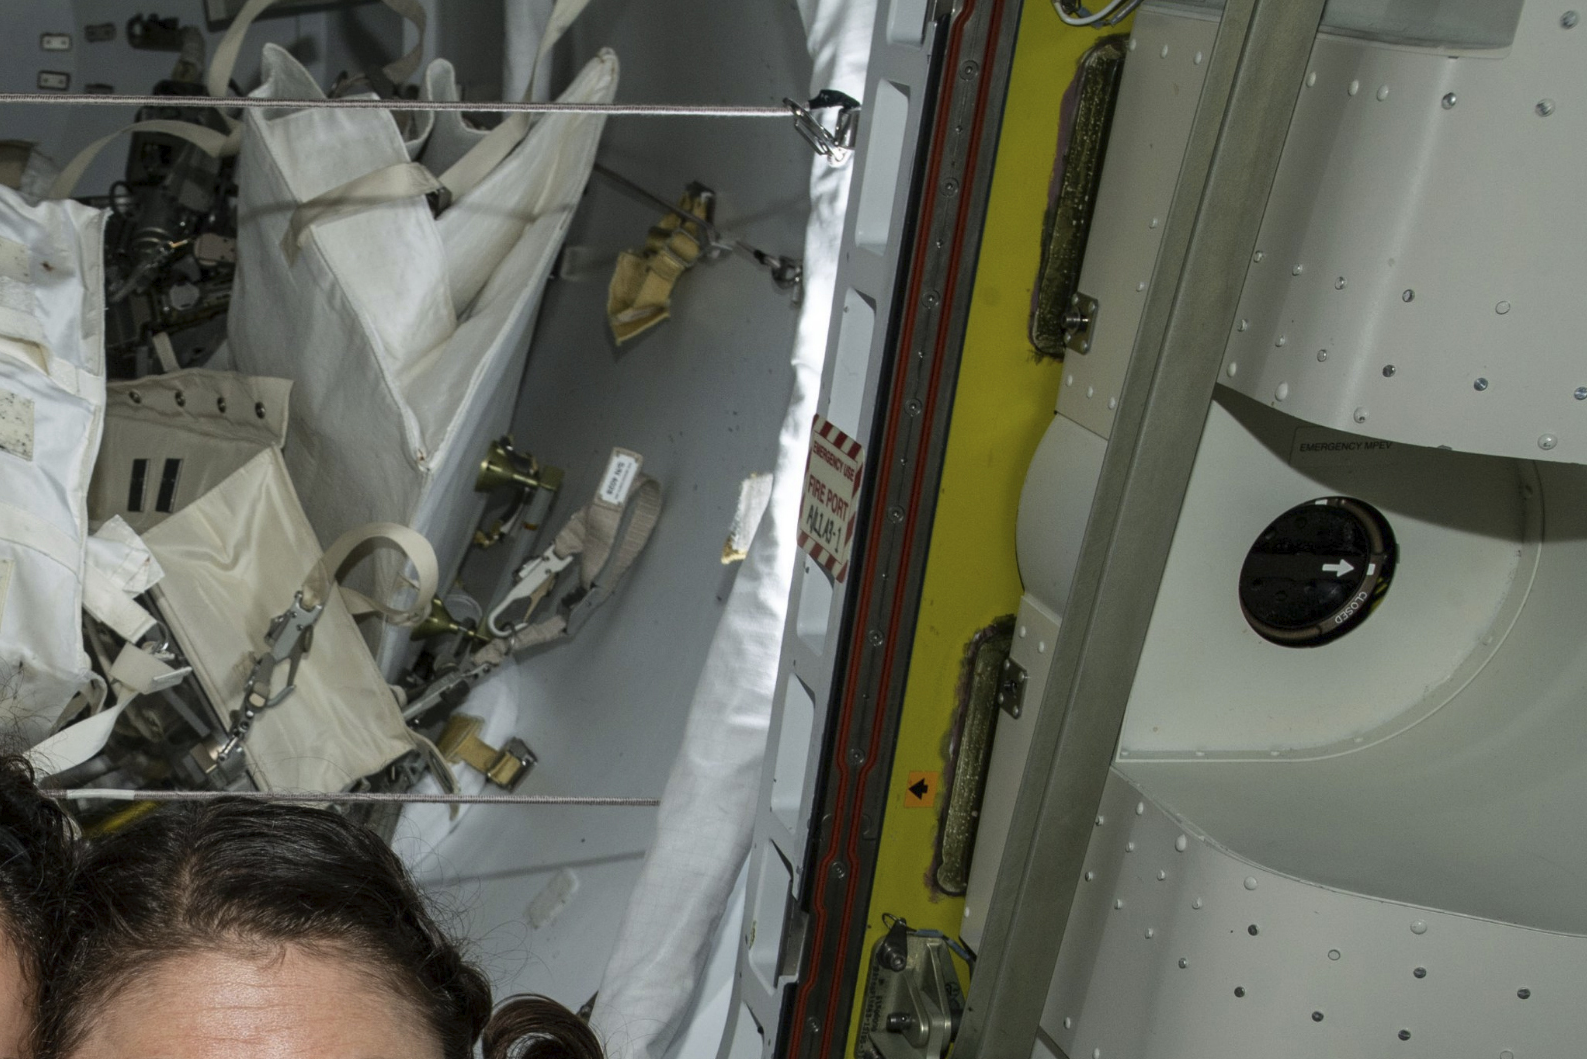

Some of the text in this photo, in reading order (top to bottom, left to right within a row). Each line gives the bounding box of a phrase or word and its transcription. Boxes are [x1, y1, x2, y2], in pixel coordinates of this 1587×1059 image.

[813, 440, 856, 482] EMERGENCY USE
[1299, 440, 1394, 453] EMERGENCY MPEV
[808, 473, 850, 523] FIRE PORT
[1334, 590, 1369, 625] CLOSED
